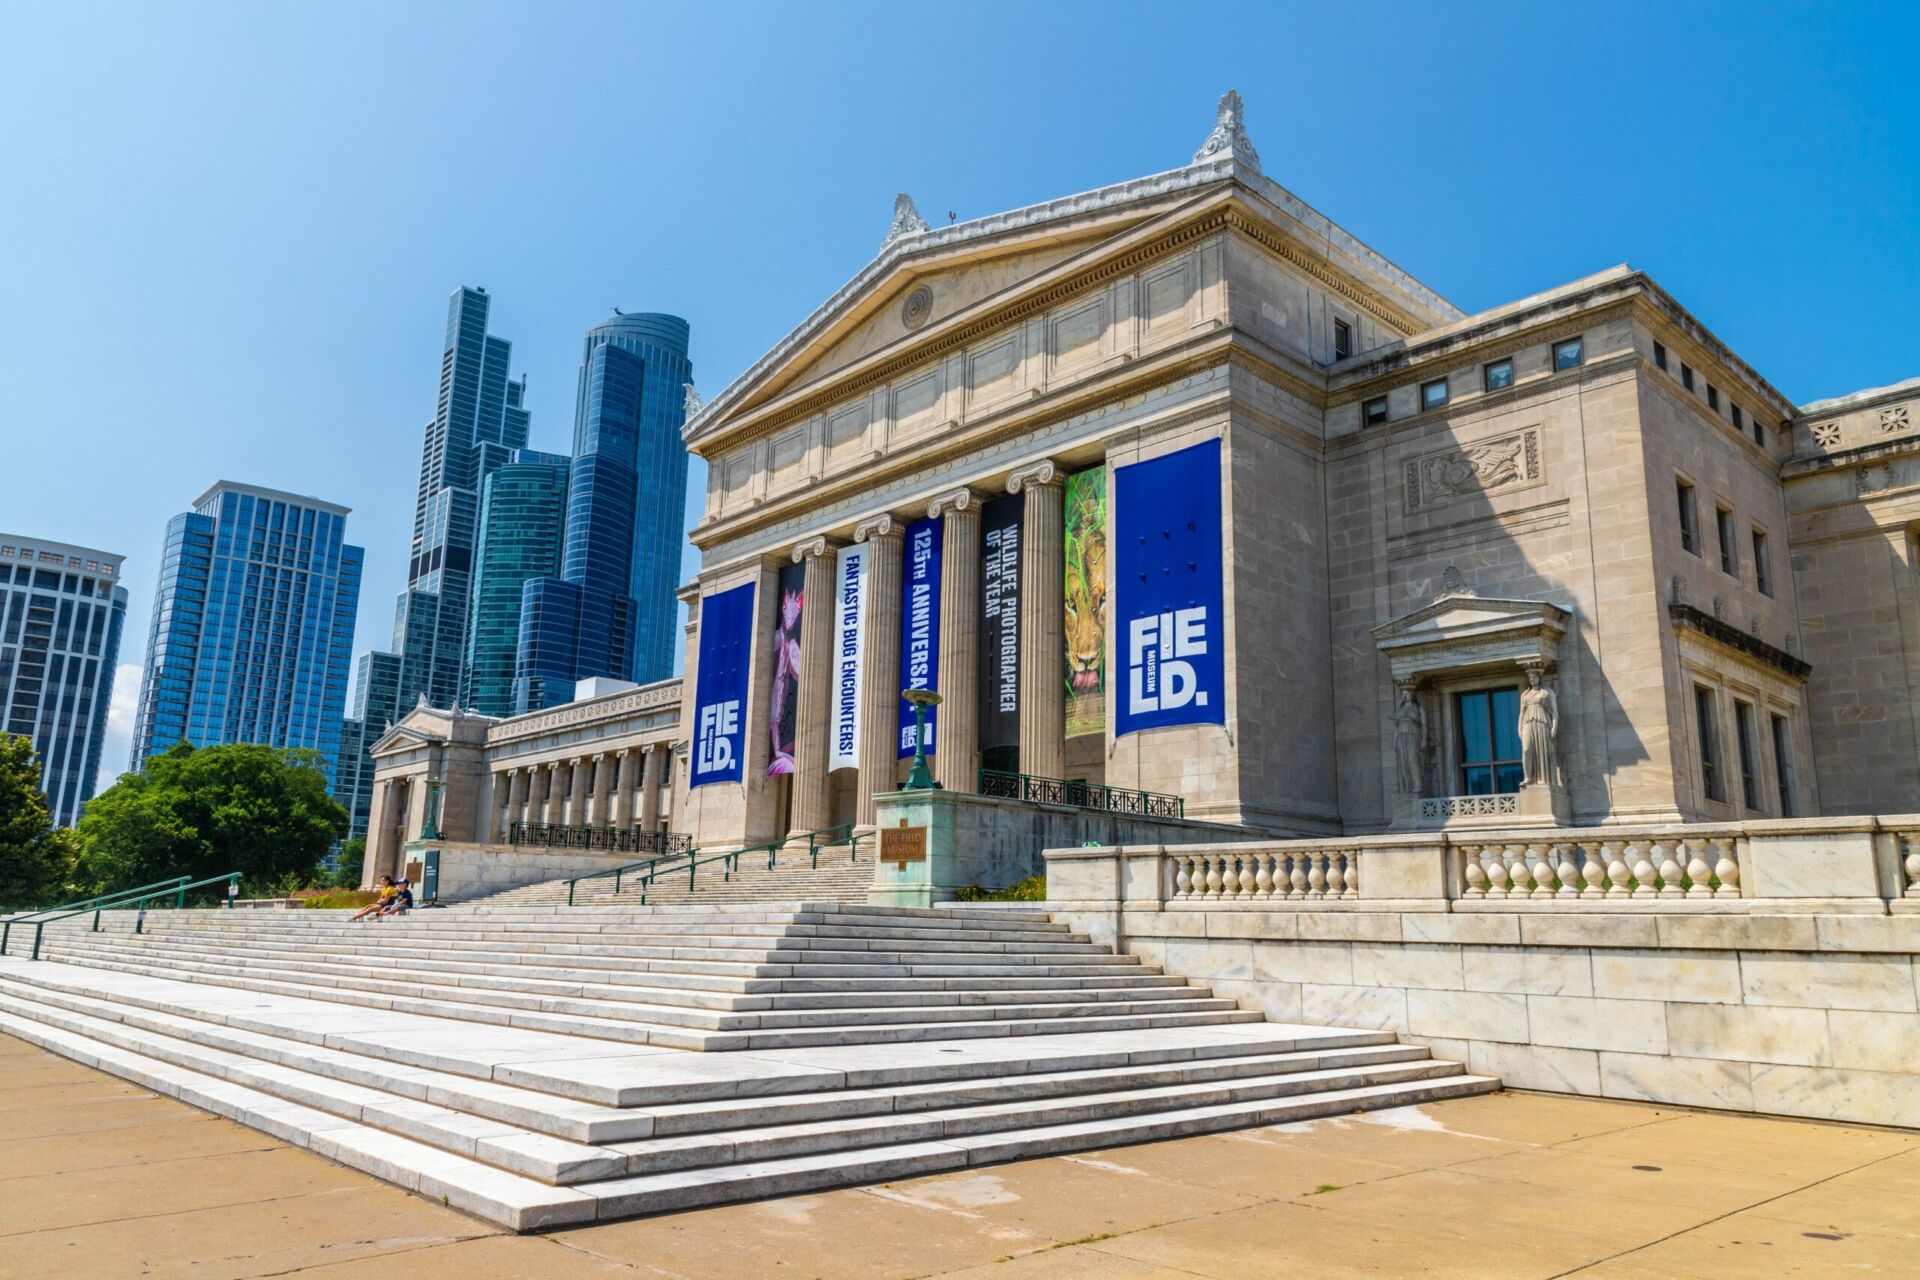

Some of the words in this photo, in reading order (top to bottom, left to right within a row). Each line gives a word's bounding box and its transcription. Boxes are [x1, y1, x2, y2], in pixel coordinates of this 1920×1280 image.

[913, 527, 932, 580] 125TH
[986, 529, 1001, 548] OF
[1002, 523, 1018, 593] WILDLIFE
[986, 549, 1001, 580] THE
[843, 555, 860, 626] FANTASTIC
[985, 579, 1001, 618] YEAR
[842, 628, 857, 658] BUG
[909, 584, 931, 712] ANNIVERSA
[1000, 597, 1017, 712] PHOTOGRAPHER
[1147, 649, 1156, 693] MUSEUM
[839, 660, 856, 756] ENCOUNTERS!
[885, 834, 899, 843] THE
[901, 831, 921, 842] FIELD
[886, 845, 918, 855] MUSEUM
